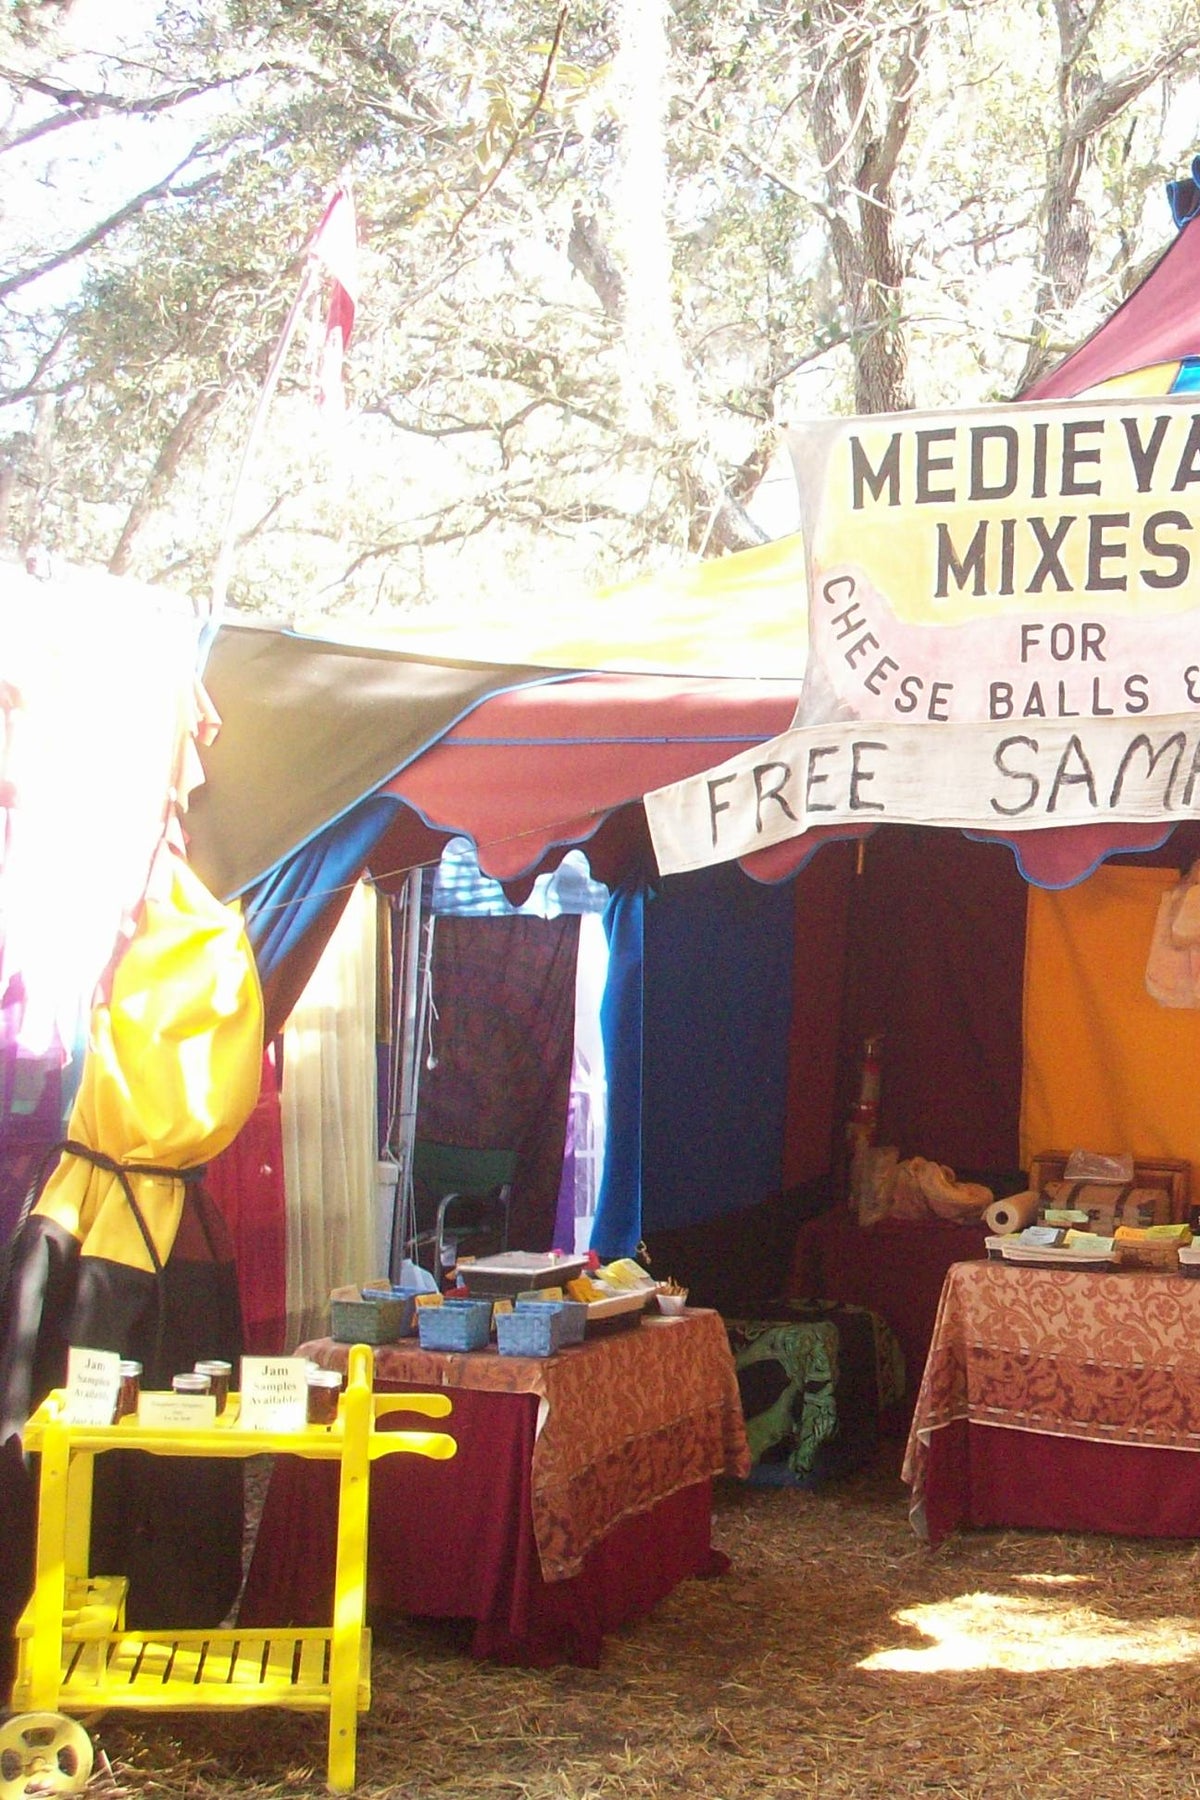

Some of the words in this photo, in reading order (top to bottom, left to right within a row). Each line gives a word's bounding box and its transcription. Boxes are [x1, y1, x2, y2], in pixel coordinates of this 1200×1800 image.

[934, 510, 1194, 598] MIXES
[822, 575, 954, 722] CHEESE
[989, 674, 1149, 720] BALLS
[1020, 622, 1107, 663] FOR
[706, 741, 889, 848] FREE
[84, 1357, 106, 1372] Jam
[261, 1365, 289, 1376] Jam
[254, 1382, 297, 1393] Samples
